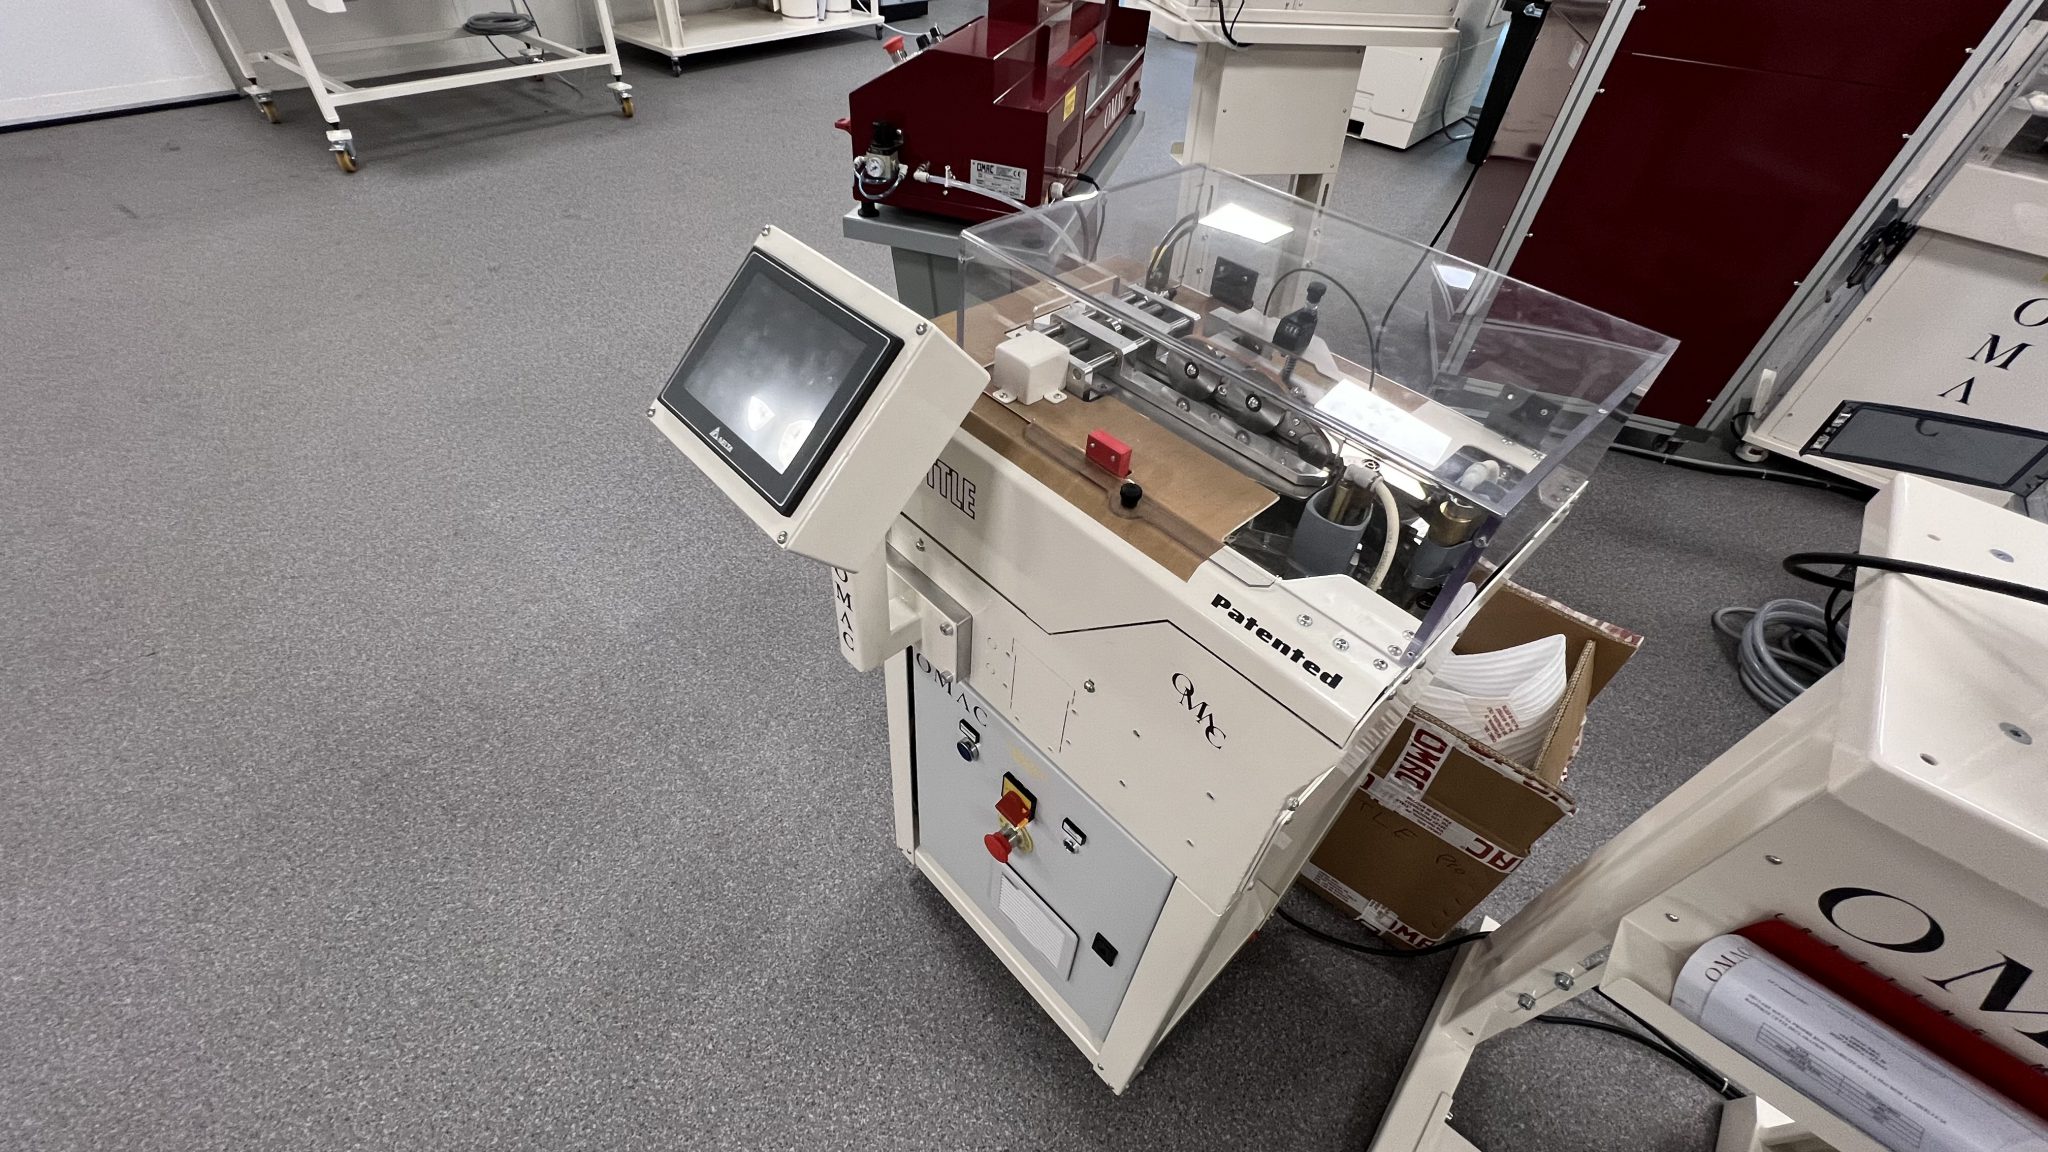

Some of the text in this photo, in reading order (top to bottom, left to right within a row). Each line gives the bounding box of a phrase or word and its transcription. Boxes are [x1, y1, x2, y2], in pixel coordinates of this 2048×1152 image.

[835, 567, 855, 652] OMAC
[1210, 593, 1344, 690] Patented
[916, 652, 988, 728] OMAC
[1171, 672, 1227, 749] OMAC
[1394, 728, 1448, 791] OMAC
